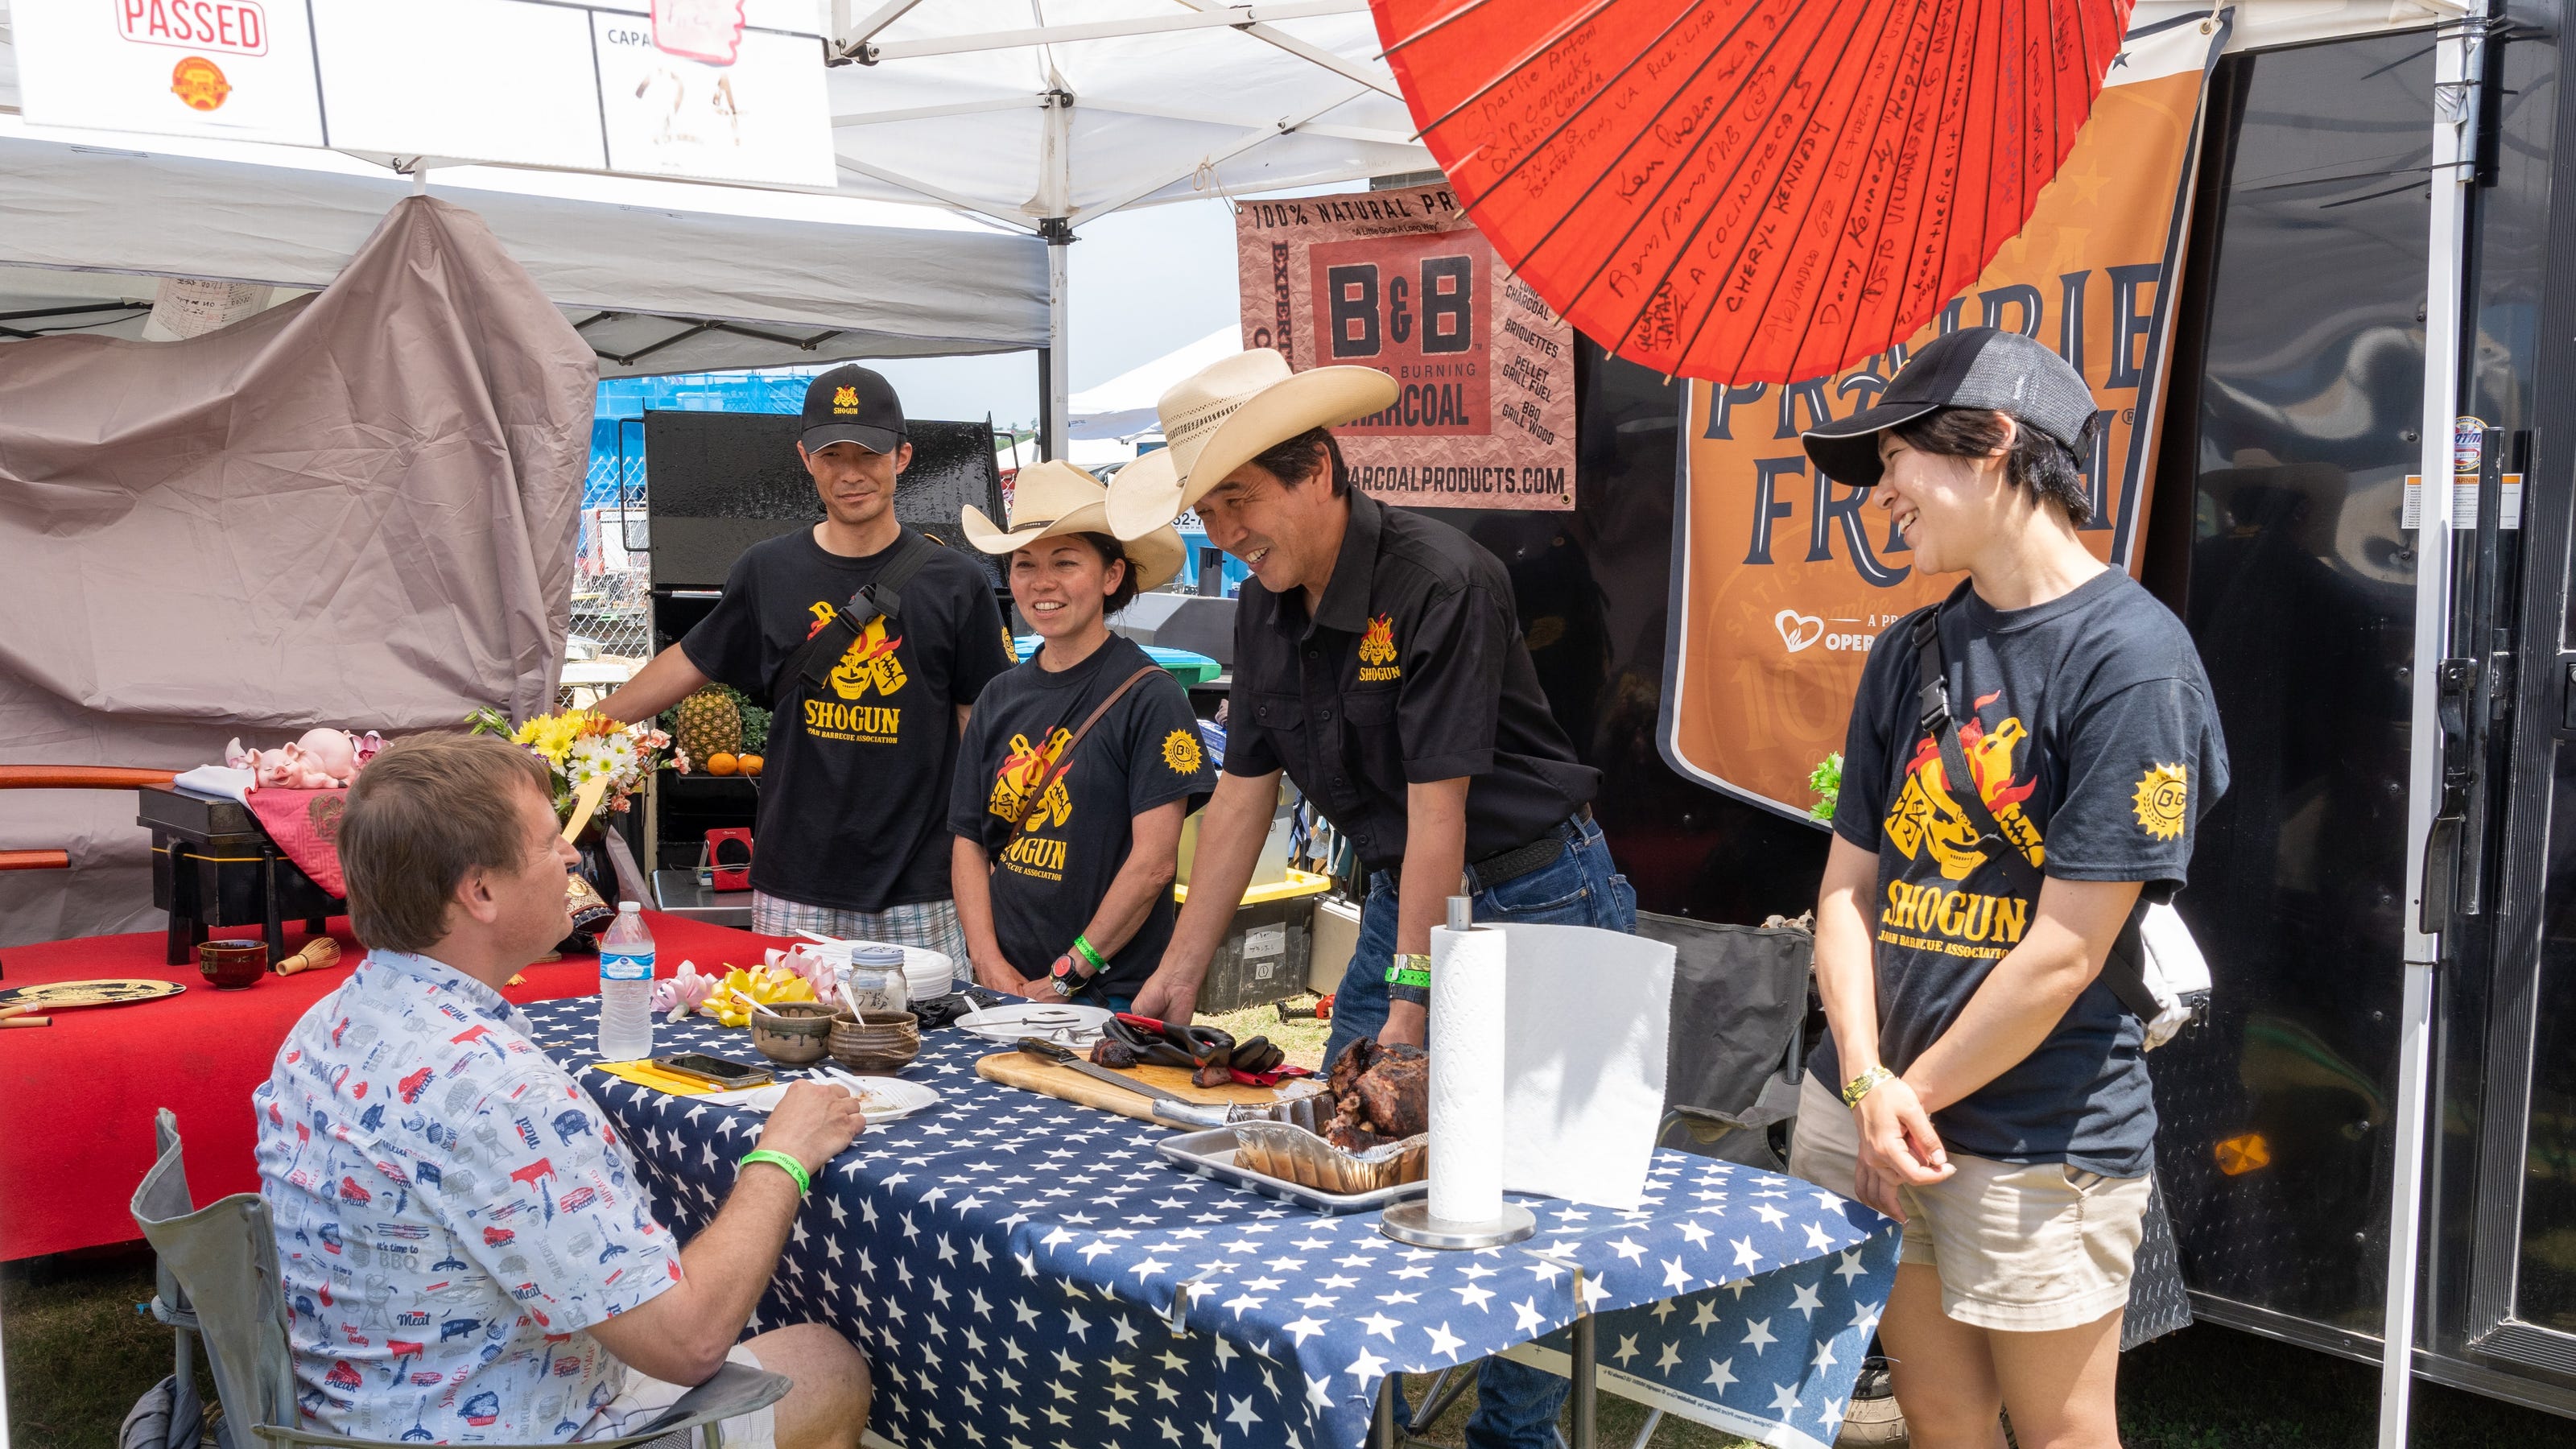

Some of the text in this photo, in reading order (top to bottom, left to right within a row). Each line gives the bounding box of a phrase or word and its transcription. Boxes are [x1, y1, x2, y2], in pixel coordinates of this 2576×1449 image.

[125, 0, 260, 48] PASSED
[608, 29, 650, 47] CAPA
[1253, 191, 1455, 229] 100% NATURAL PR
[1725, 121, 1831, 312] CHERYL KENNEDY
[1362, 227, 1379, 235] Little
[1405, 224, 1422, 233] Long
[1505, 284, 1549, 321] CHARCOAL
[1505, 318, 1558, 358] BRIQUETTES
[1401, 363, 1476, 378] BURNING
[1515, 355, 1549, 384] PELLET
[1503, 364, 1551, 402] GRILL FUEL
[1521, 401, 1541, 423] BBQ
[1502, 404, 1555, 445] GRILL WOOD
[1350, 465, 1565, 494] ARCOALPRODUCTS.COM
[1868, 615, 1876, 626] A
[1825, 634, 1874, 651] OPER
[1359, 666, 1401, 681] SHOGUN
[805, 700, 901, 733] SHOGUN
[821, 731, 856, 741] BARBECUE
[857, 735, 898, 744] ASSOCIATION
[1005, 837, 1067, 870] OGUN
[1024, 868, 1063, 881] ASSOCIATION
[1882, 879, 2028, 943] SHOGUN
[589, 1169, 617, 1210] SAUSAGES
[570, 1193, 598, 1214] Bacon
[377, 1242, 419, 1254] It's time to
[379, 1252, 419, 1274] BBQ
[511, 1283, 542, 1301] Meat
[397, 1313, 431, 1326] Meat
[516, 1315, 531, 1327] Fin
